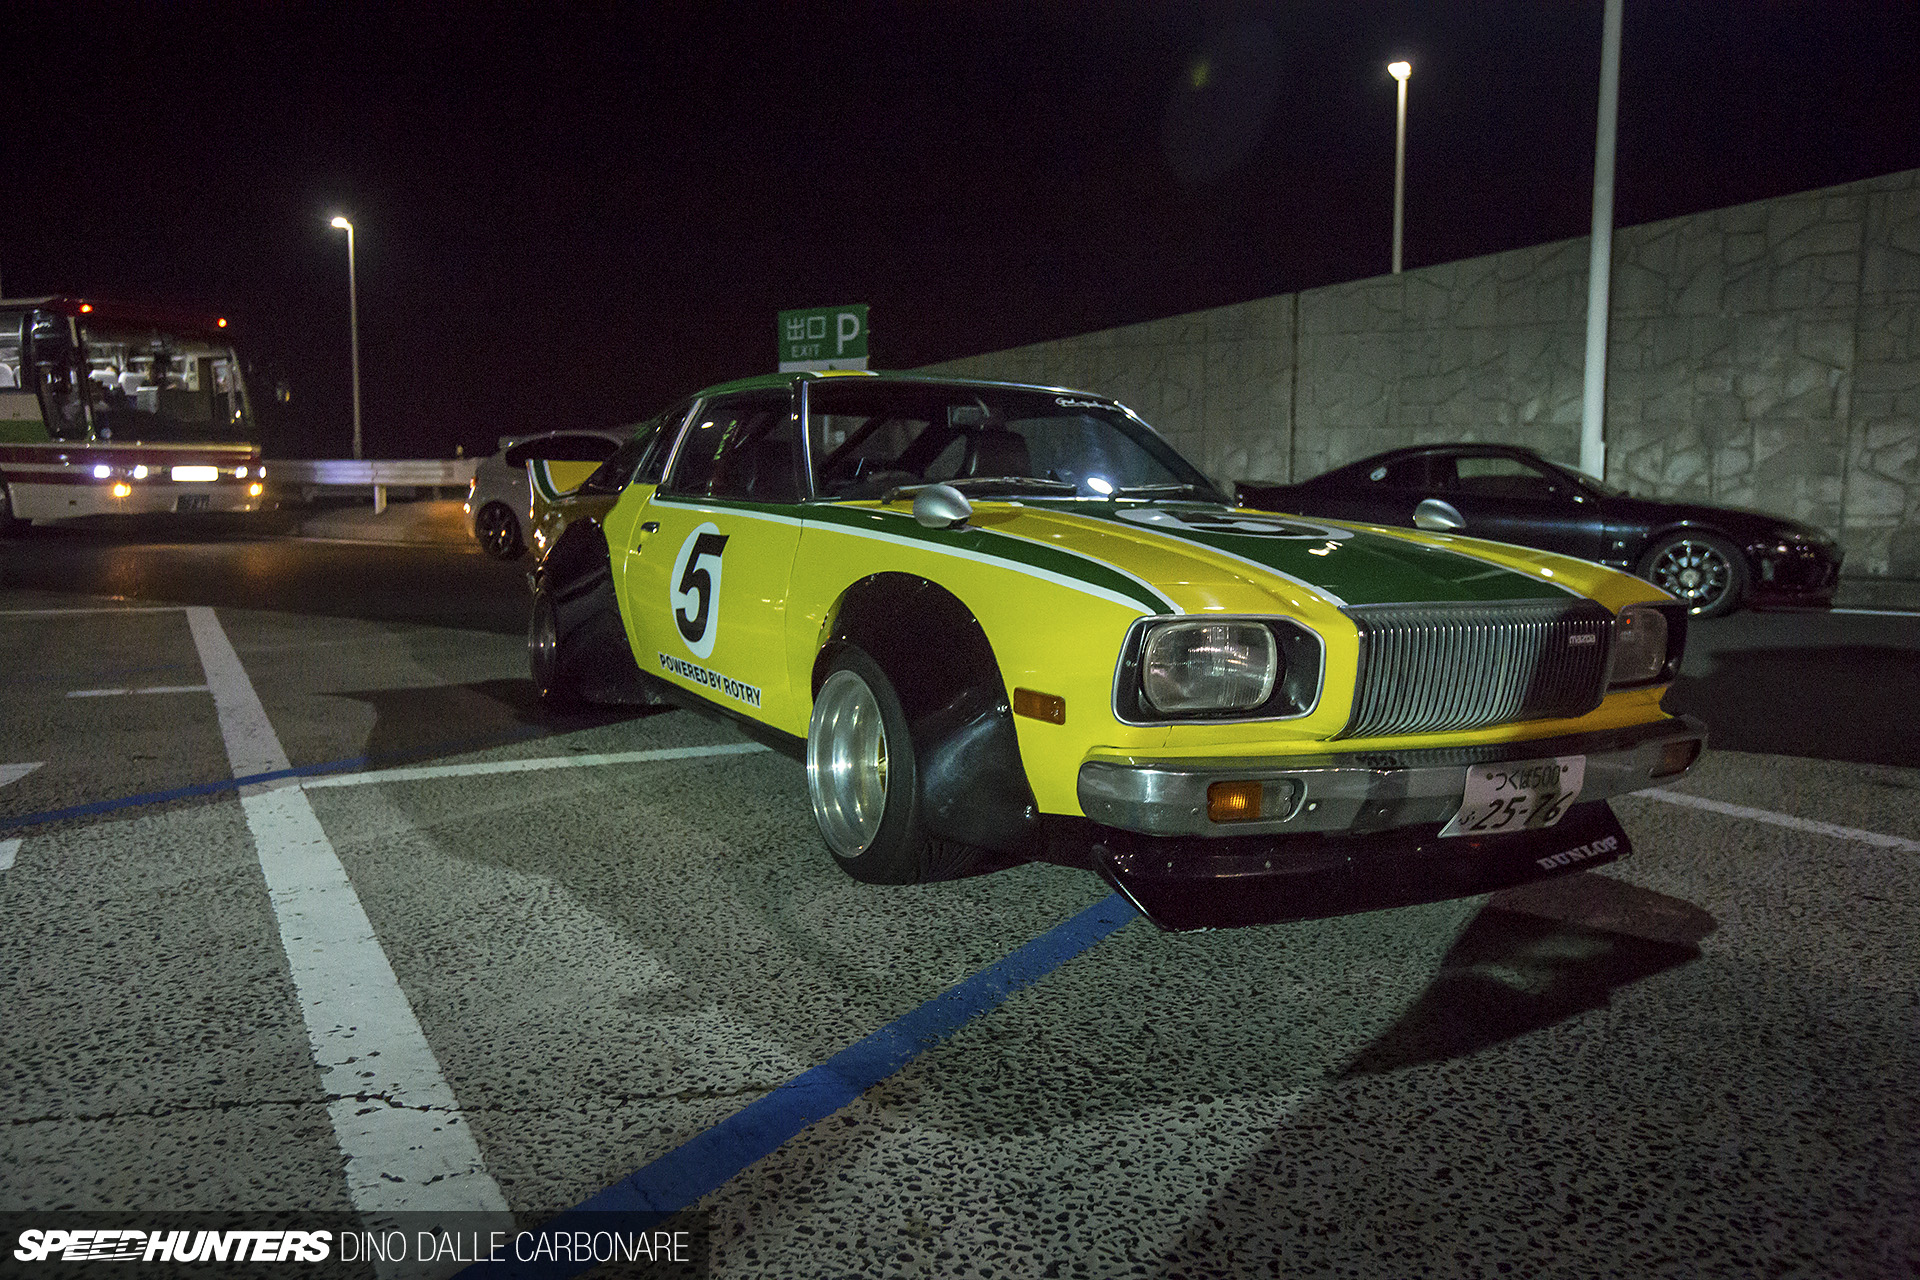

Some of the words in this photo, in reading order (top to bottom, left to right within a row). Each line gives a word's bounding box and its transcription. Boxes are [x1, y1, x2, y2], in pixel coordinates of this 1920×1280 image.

[786, 316, 826, 340] 出口
[837, 313, 859, 354] P
[791, 343, 819, 358] EXIT
[676, 532, 730, 643] 5
[659, 653, 707, 685] POWERED
[708, 670, 723, 691] BY
[723, 679, 761, 708] ROTRY
[1469, 791, 1574, 831] 25-76
[1536, 836, 1618, 870] DUNLOP
